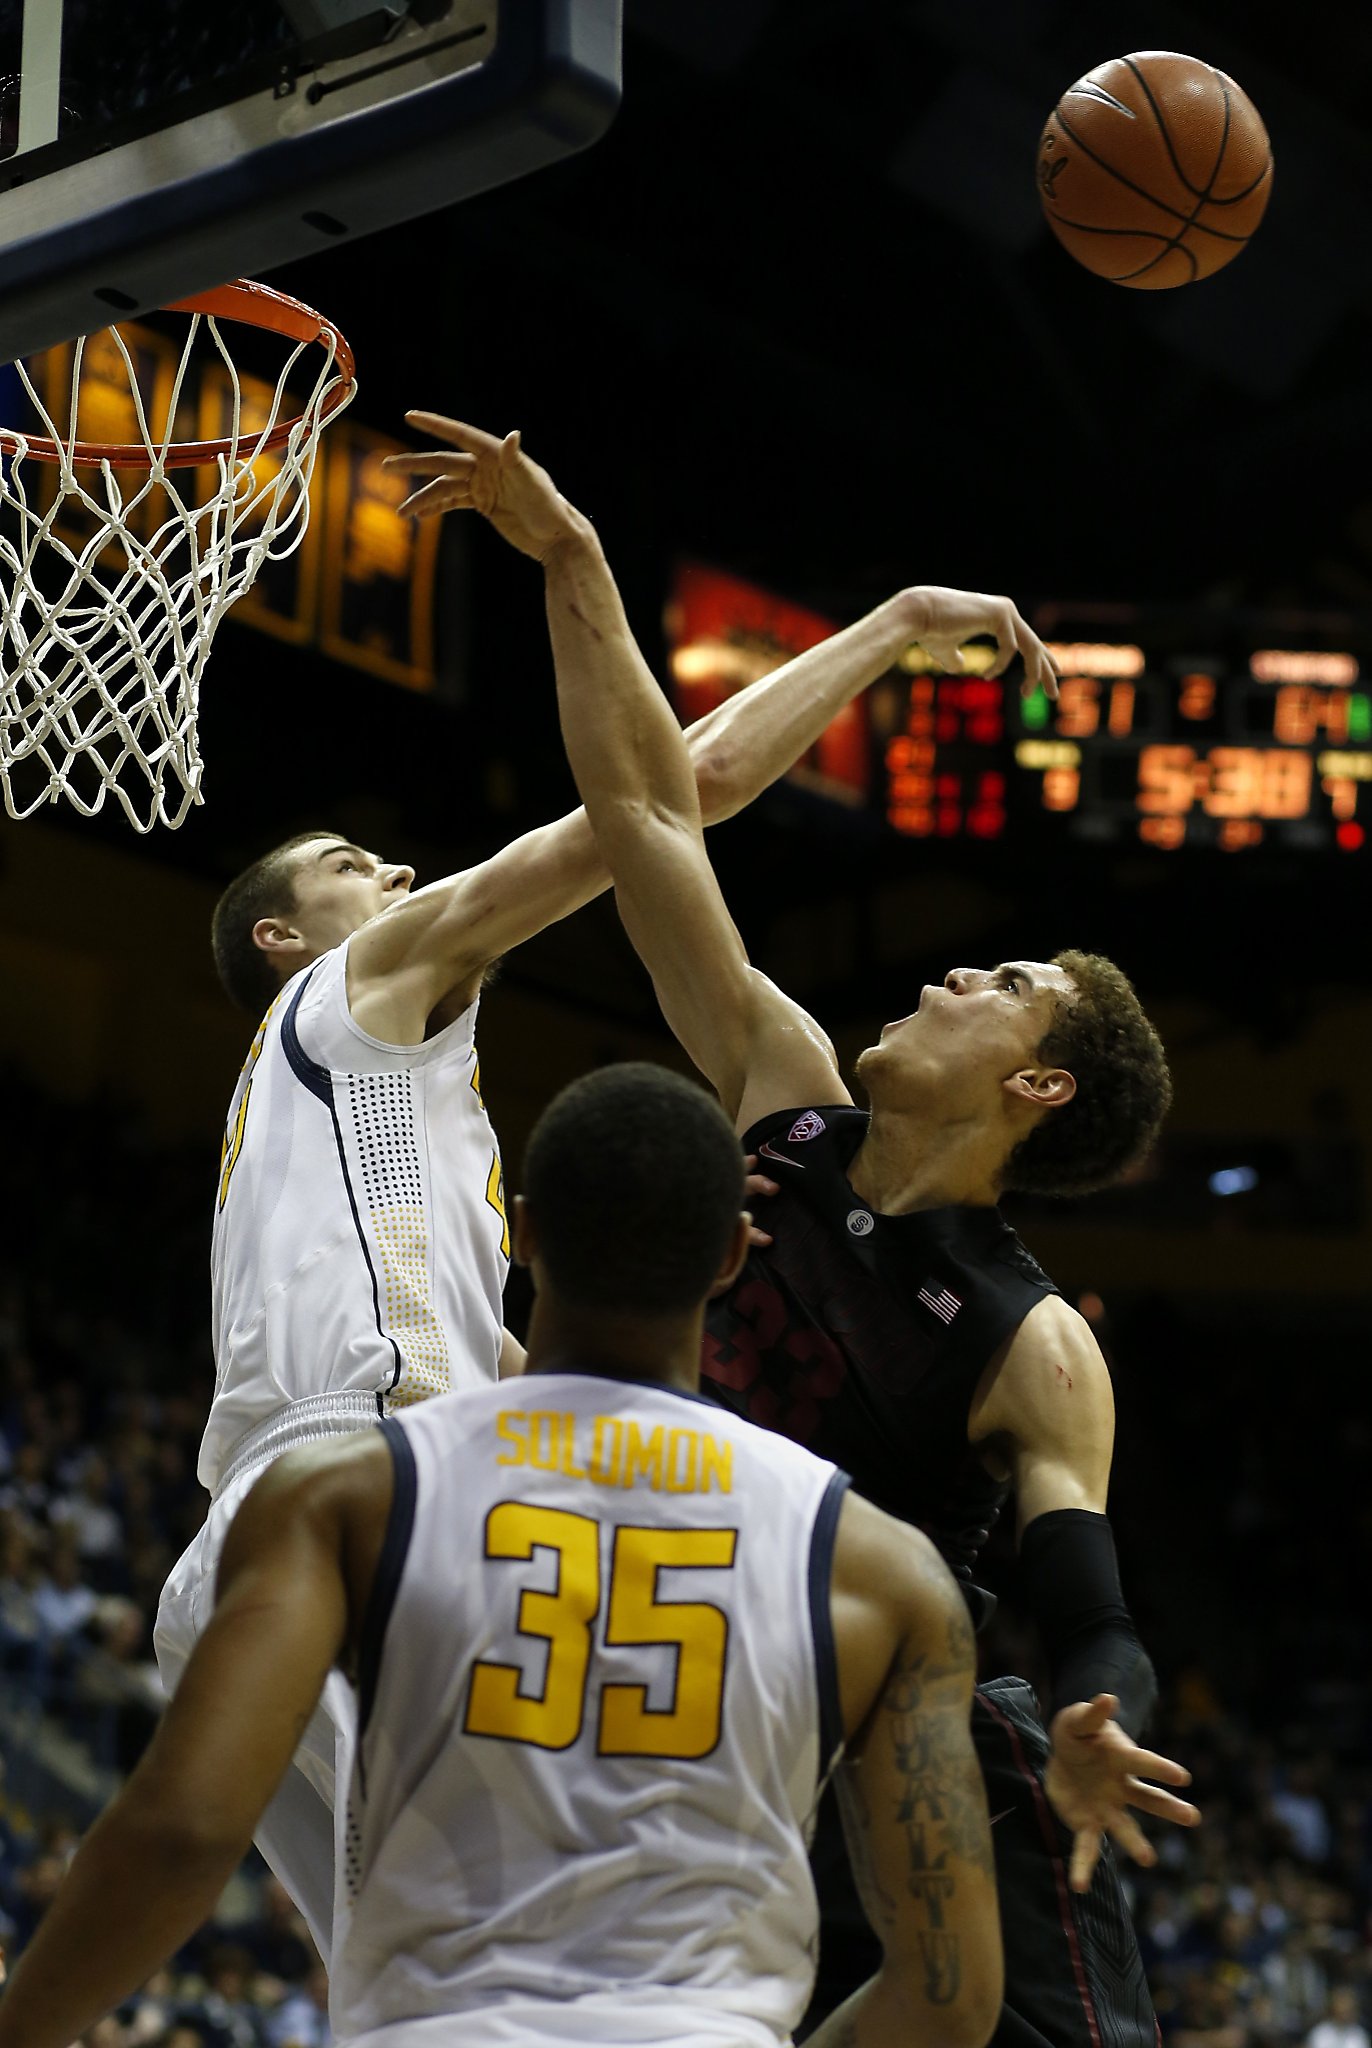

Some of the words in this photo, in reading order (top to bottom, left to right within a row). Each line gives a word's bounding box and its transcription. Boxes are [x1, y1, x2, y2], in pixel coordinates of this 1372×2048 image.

[850, 1215, 869, 1233] S
[495, 1409, 733, 1494] SOLOMON
[462, 1500, 738, 1760] 35
